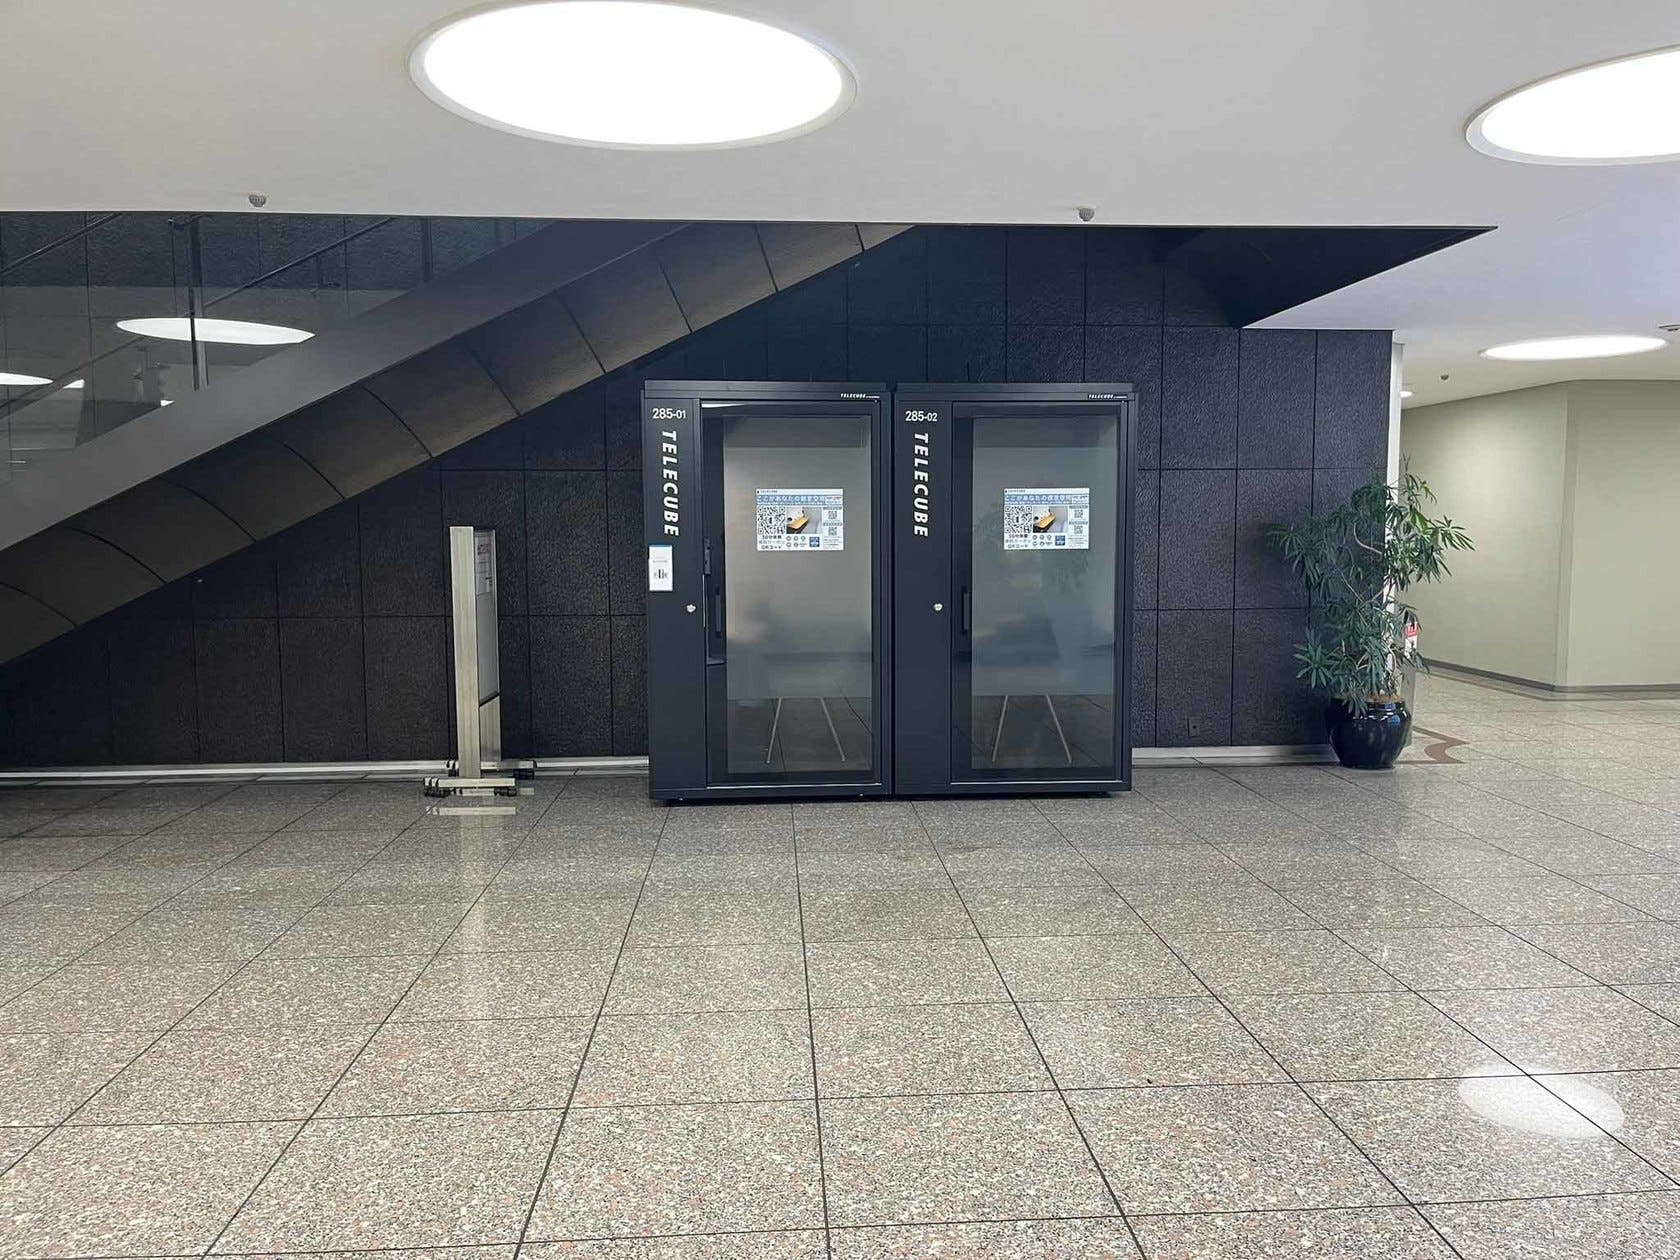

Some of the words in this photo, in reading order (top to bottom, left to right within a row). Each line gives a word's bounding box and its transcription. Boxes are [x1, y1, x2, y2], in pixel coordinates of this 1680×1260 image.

[652, 408, 686, 419] 285-01
[905, 410, 938, 422] 285-02
[662, 430, 679, 536] TELECUBE
[914, 433, 929, 537] TELECUBE
